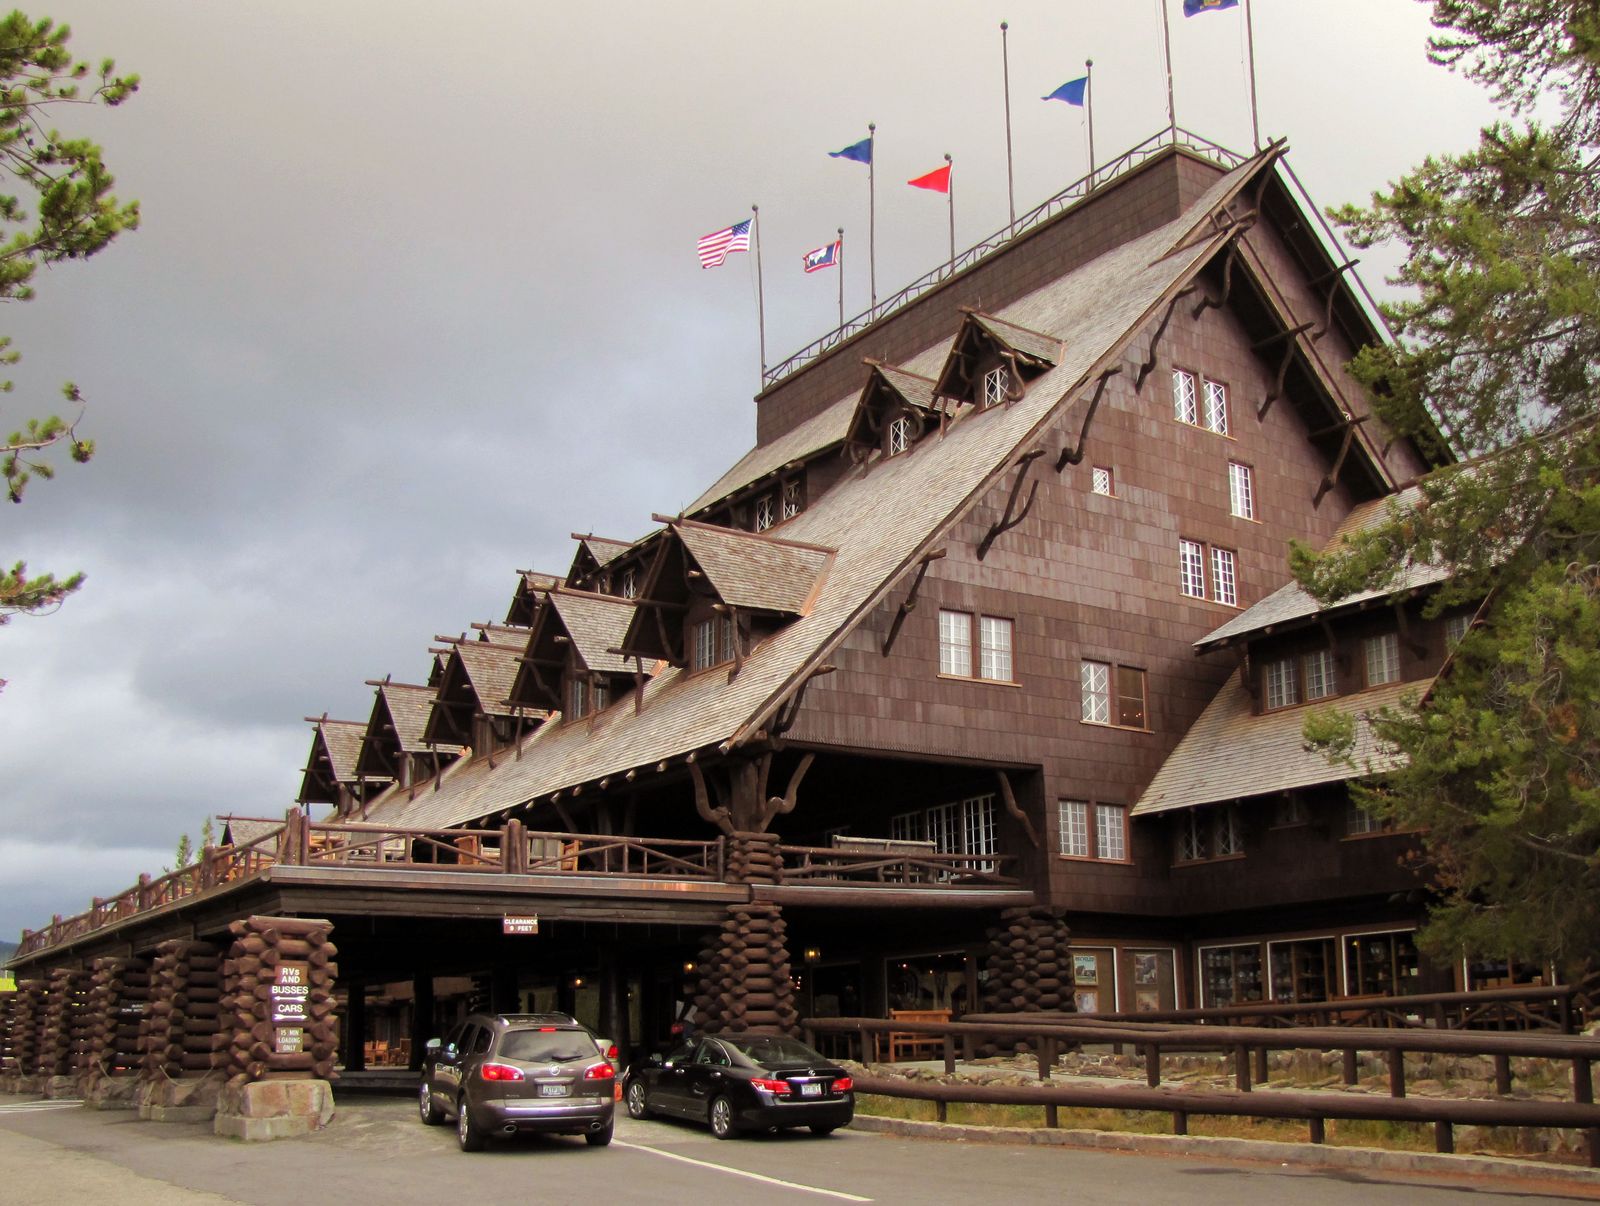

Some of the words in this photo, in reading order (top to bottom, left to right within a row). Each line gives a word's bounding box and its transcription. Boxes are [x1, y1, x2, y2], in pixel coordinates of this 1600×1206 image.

[282, 967, 300, 975] RVs
[281, 976, 301, 984] AND
[271, 985, 309, 994] BUSSES
[278, 1004, 304, 1012] CARS
